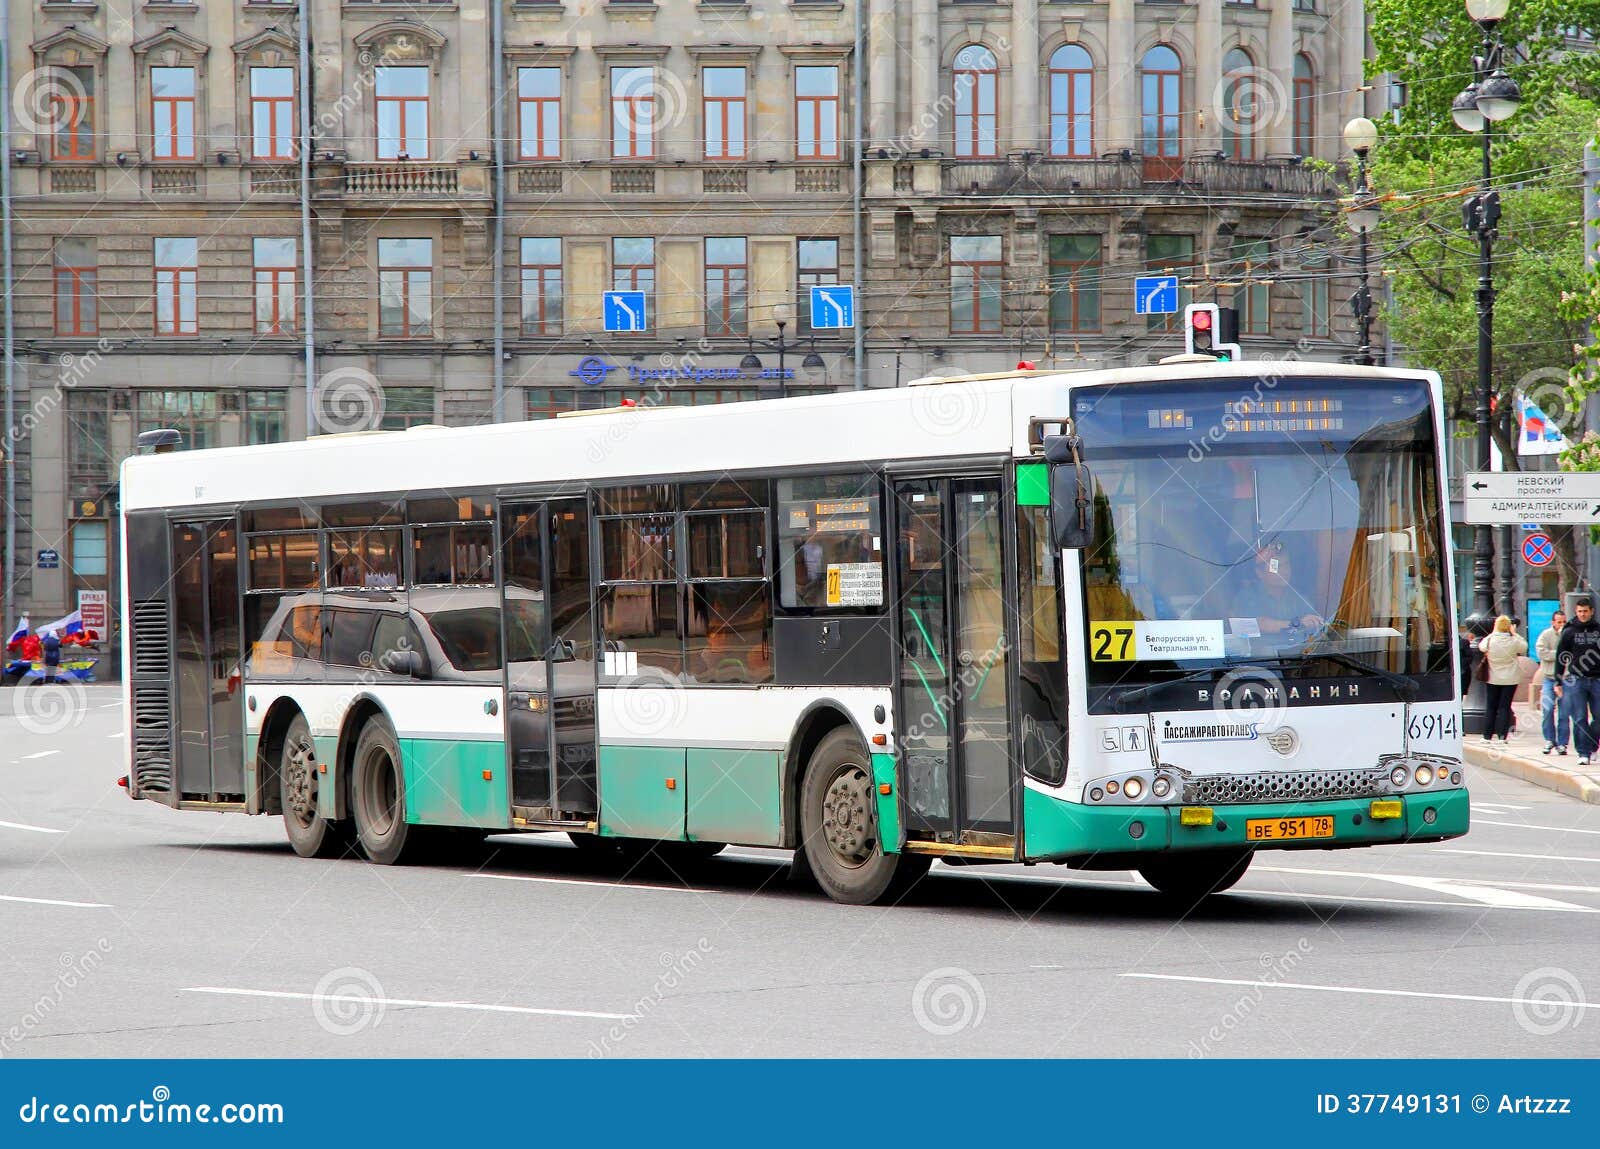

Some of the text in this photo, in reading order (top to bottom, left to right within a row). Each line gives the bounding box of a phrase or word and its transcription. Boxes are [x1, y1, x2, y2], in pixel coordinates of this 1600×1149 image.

[1517, 475, 1564, 486] НЕВСКИЙ
[1517, 487, 1562, 496] проспект
[1491, 500, 1588, 511] АДМИРАЛТЕЙСКИЙ
[1517, 512, 1562, 520] проспект
[828, 571, 838, 595] 27
[1094, 628, 1133, 661] 27
[1145, 635, 1194, 644] Белорусская
[1149, 644, 1198, 653] Театральная
[1198, 684, 1359, 702] ВОЛЖАНИН
[1408, 713, 1457, 740] 6914
[1279, 820, 1306, 837] 951
[1314, 818, 1328, 830] 78
